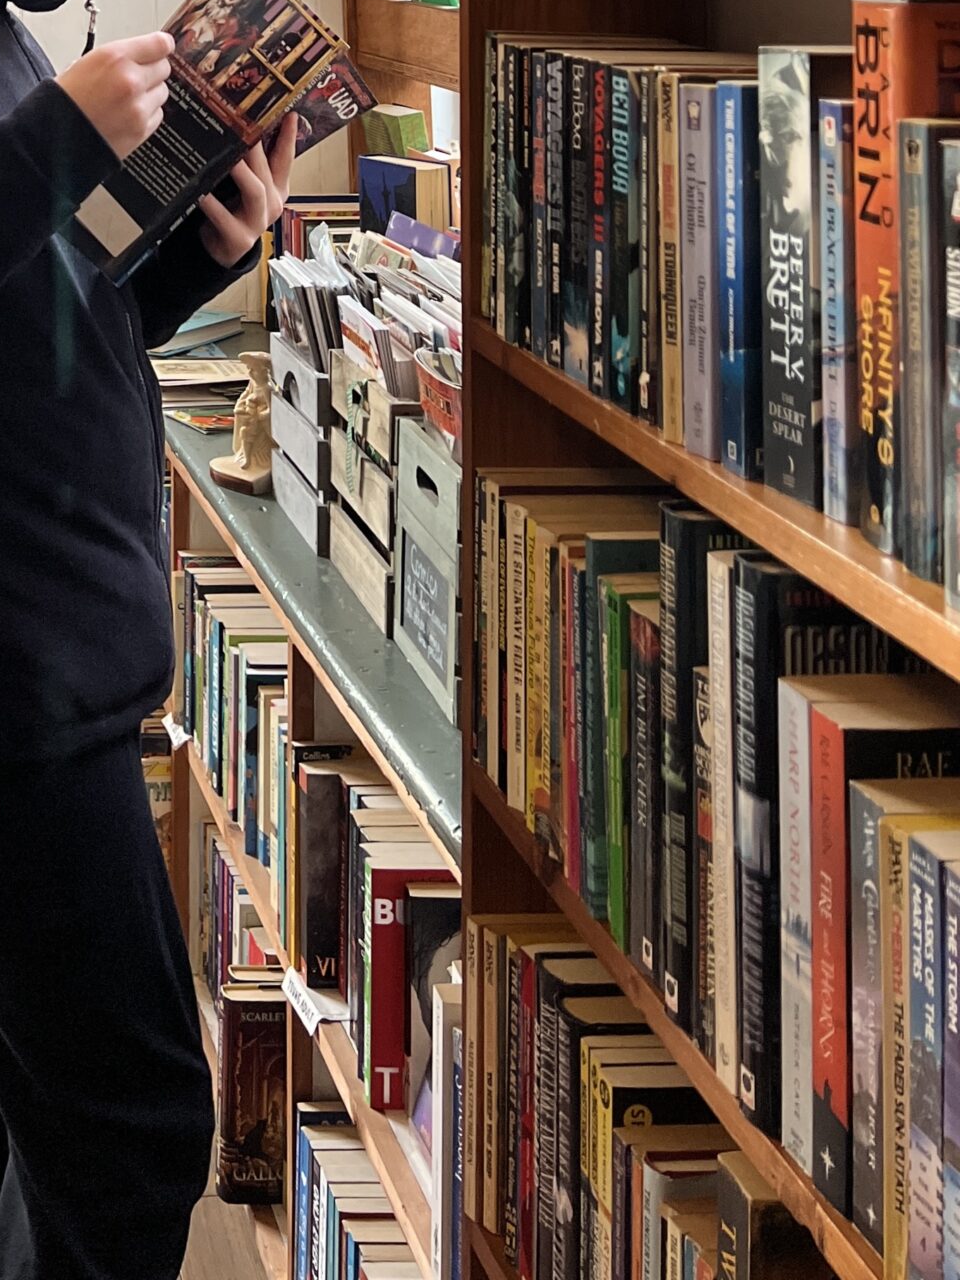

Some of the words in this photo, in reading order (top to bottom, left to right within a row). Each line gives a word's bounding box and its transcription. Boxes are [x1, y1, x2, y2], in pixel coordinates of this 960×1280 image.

[283, 89, 307, 113] SQUAD
[316, 72, 359, 120] SQUAD
[508, 94, 515, 116] OF
[572, 64, 585, 99] Ben
[611, 75, 629, 127] BEN
[546, 59, 564, 202] VOYAGERS
[571, 101, 585, 150] Bova
[593, 68, 606, 206] VOYAGERS
[725, 98, 735, 130] THE
[854, 18, 882, 225] BRIN
[611, 127, 629, 195] BOVA
[725, 132, 736, 209] CRUCIBLE
[826, 159, 837, 200] THE
[536, 218, 544, 248] BEN
[546, 207, 564, 235] II
[594, 213, 606, 242] III
[725, 211, 736, 234] OF
[536, 249, 544, 288] BOVA
[552, 242, 560, 264] BEN
[594, 249, 604, 289] BEN
[725, 236, 736, 280] TIME
[826, 206, 838, 306] PRACTICE
[552, 265, 560, 294] BOVA
[662, 241, 679, 346] STORMQUEEN!
[766, 228, 792, 367] BRETT
[788, 233, 805, 347] PETER
[945, 246, 960, 319] STATION
[594, 291, 603, 346] BOVA
[788, 352, 805, 381] V.
[860, 293, 876, 435] SHORE
[876, 265, 895, 466] INFINITY'S
[768, 400, 807, 429] DESERT
[772, 420, 804, 447] SPEAR
[513, 533, 523, 557] THE
[528, 535, 536, 565] The
[499, 562, 506, 579] OF
[572, 573, 580, 609] NOVA
[513, 559, 523, 637] SHOCKWAVE
[528, 567, 536, 631] Furious
[528, 633, 536, 689] Future
[573, 610, 581, 664] EXPRESS
[513, 644, 523, 687] RIDER
[575, 671, 583, 723] WILLIAM
[636, 672, 647, 710] JIM
[527, 696, 537, 758] Budrys
[787, 707, 800, 795] SHARP
[637, 716, 648, 828] BUTCHER
[788, 802, 801, 905] NORTH
[818, 869, 834, 928] FIRE
[891, 904, 905, 996] CHERRYH
[911, 882, 924, 983] MARTYRS
[924, 890, 936, 963] MASKS
[947, 913, 958, 958] THE
[510, 965, 519, 995] THE
[925, 966, 935, 997] OF
[947, 958, 959, 1035] STORM
[510, 1000, 519, 1036] RED
[793, 1002, 801, 1070] PATRICK
[818, 957, 836, 1065] THORNS
[893, 1001, 905, 1041] THE
[924, 1002, 936, 1046] THE
[509, 1038, 519, 1107] PLANET
[893, 1042, 906, 1096] FADED
[793, 1076, 801, 1122] CAVE
[894, 1097, 907, 1139] SUN:
[558, 1109, 571, 1183] CLARKE
[643, 1188, 651, 1214] THE
[893, 1141, 906, 1215] KUTATH
